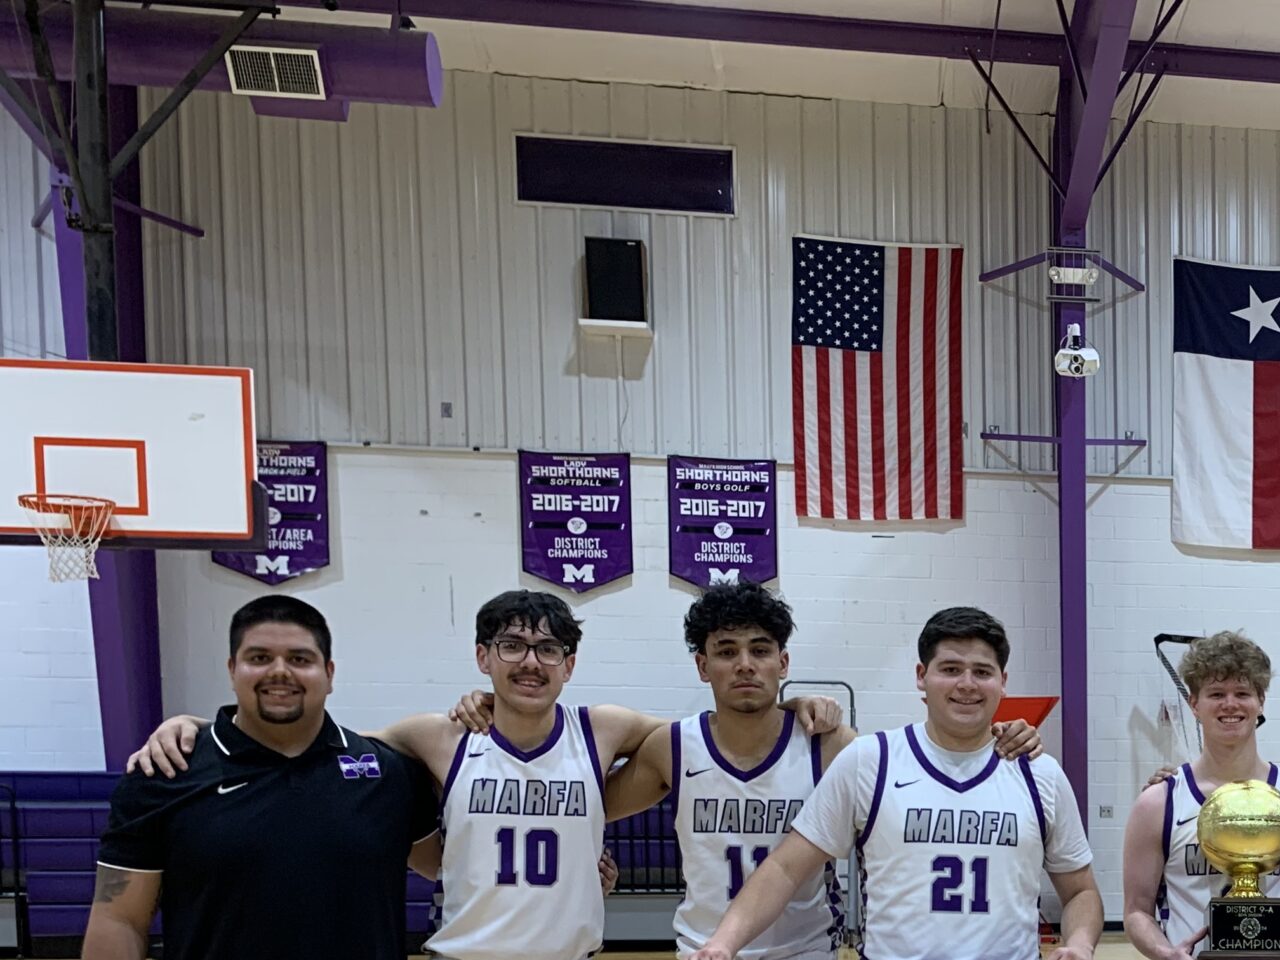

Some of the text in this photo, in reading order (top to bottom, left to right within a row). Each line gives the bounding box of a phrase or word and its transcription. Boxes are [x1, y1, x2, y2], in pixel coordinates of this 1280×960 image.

[258, 456, 316, 468] THORNS
[531, 466, 620, 478] SHORTHORNS
[676, 468, 769, 483] SHORTHORNS
[550, 478, 601, 486] SOFTBALL
[695, 483, 750, 492] BOYS GOLF
[267, 484, 316, 503] -2017
[531, 494, 620, 512] 2016-2017
[679, 498, 766, 517] 2016-2017
[268, 541, 303, 550] PIONS
[554, 537, 600, 549] DISTRICT
[701, 542, 746, 554] DISTRICT
[548, 549, 608, 559] CHAMPIONS
[695, 553, 753, 563] CHAMPIONS
[255, 555, 289, 575] M
[562, 564, 595, 583] M
[709, 568, 740, 586] M
[468, 778, 587, 817] MARFA
[693, 799, 804, 834] MARFA
[904, 808, 1018, 846] MARFA
[494, 826, 560, 887] 10
[929, 855, 990, 914] 21
[1260, 906, 1274, 914] 9-A
